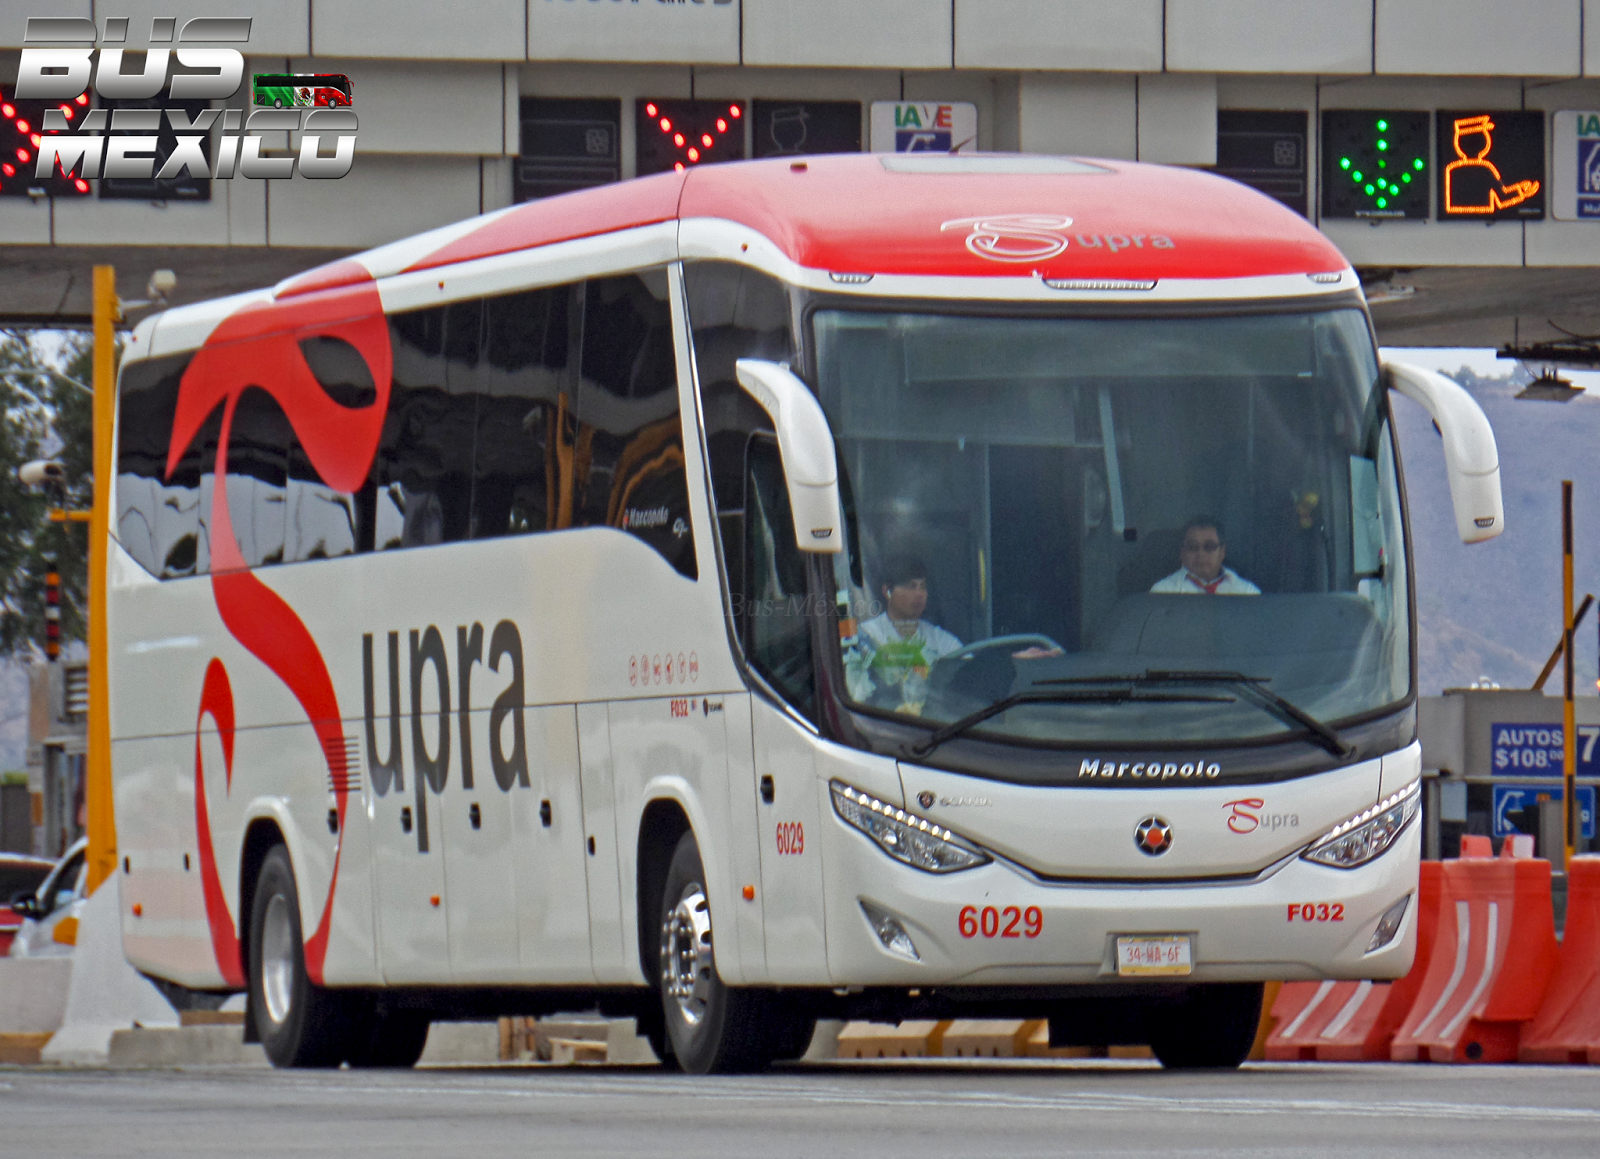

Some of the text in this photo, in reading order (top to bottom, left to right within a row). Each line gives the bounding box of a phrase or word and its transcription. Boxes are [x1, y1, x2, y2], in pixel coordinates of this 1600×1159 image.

[895, 105, 952, 128] IAVE
[671, 699, 688, 717] F032
[1497, 729, 1563, 746] AUTOS
[1578, 727, 1600, 762] 7
[1078, 758, 1221, 780] Marcopolo
[1222, 797, 1299, 834] Supra
[776, 822, 804, 855] 6029
[958, 905, 1043, 938] 6029
[1287, 903, 1345, 922] F032
